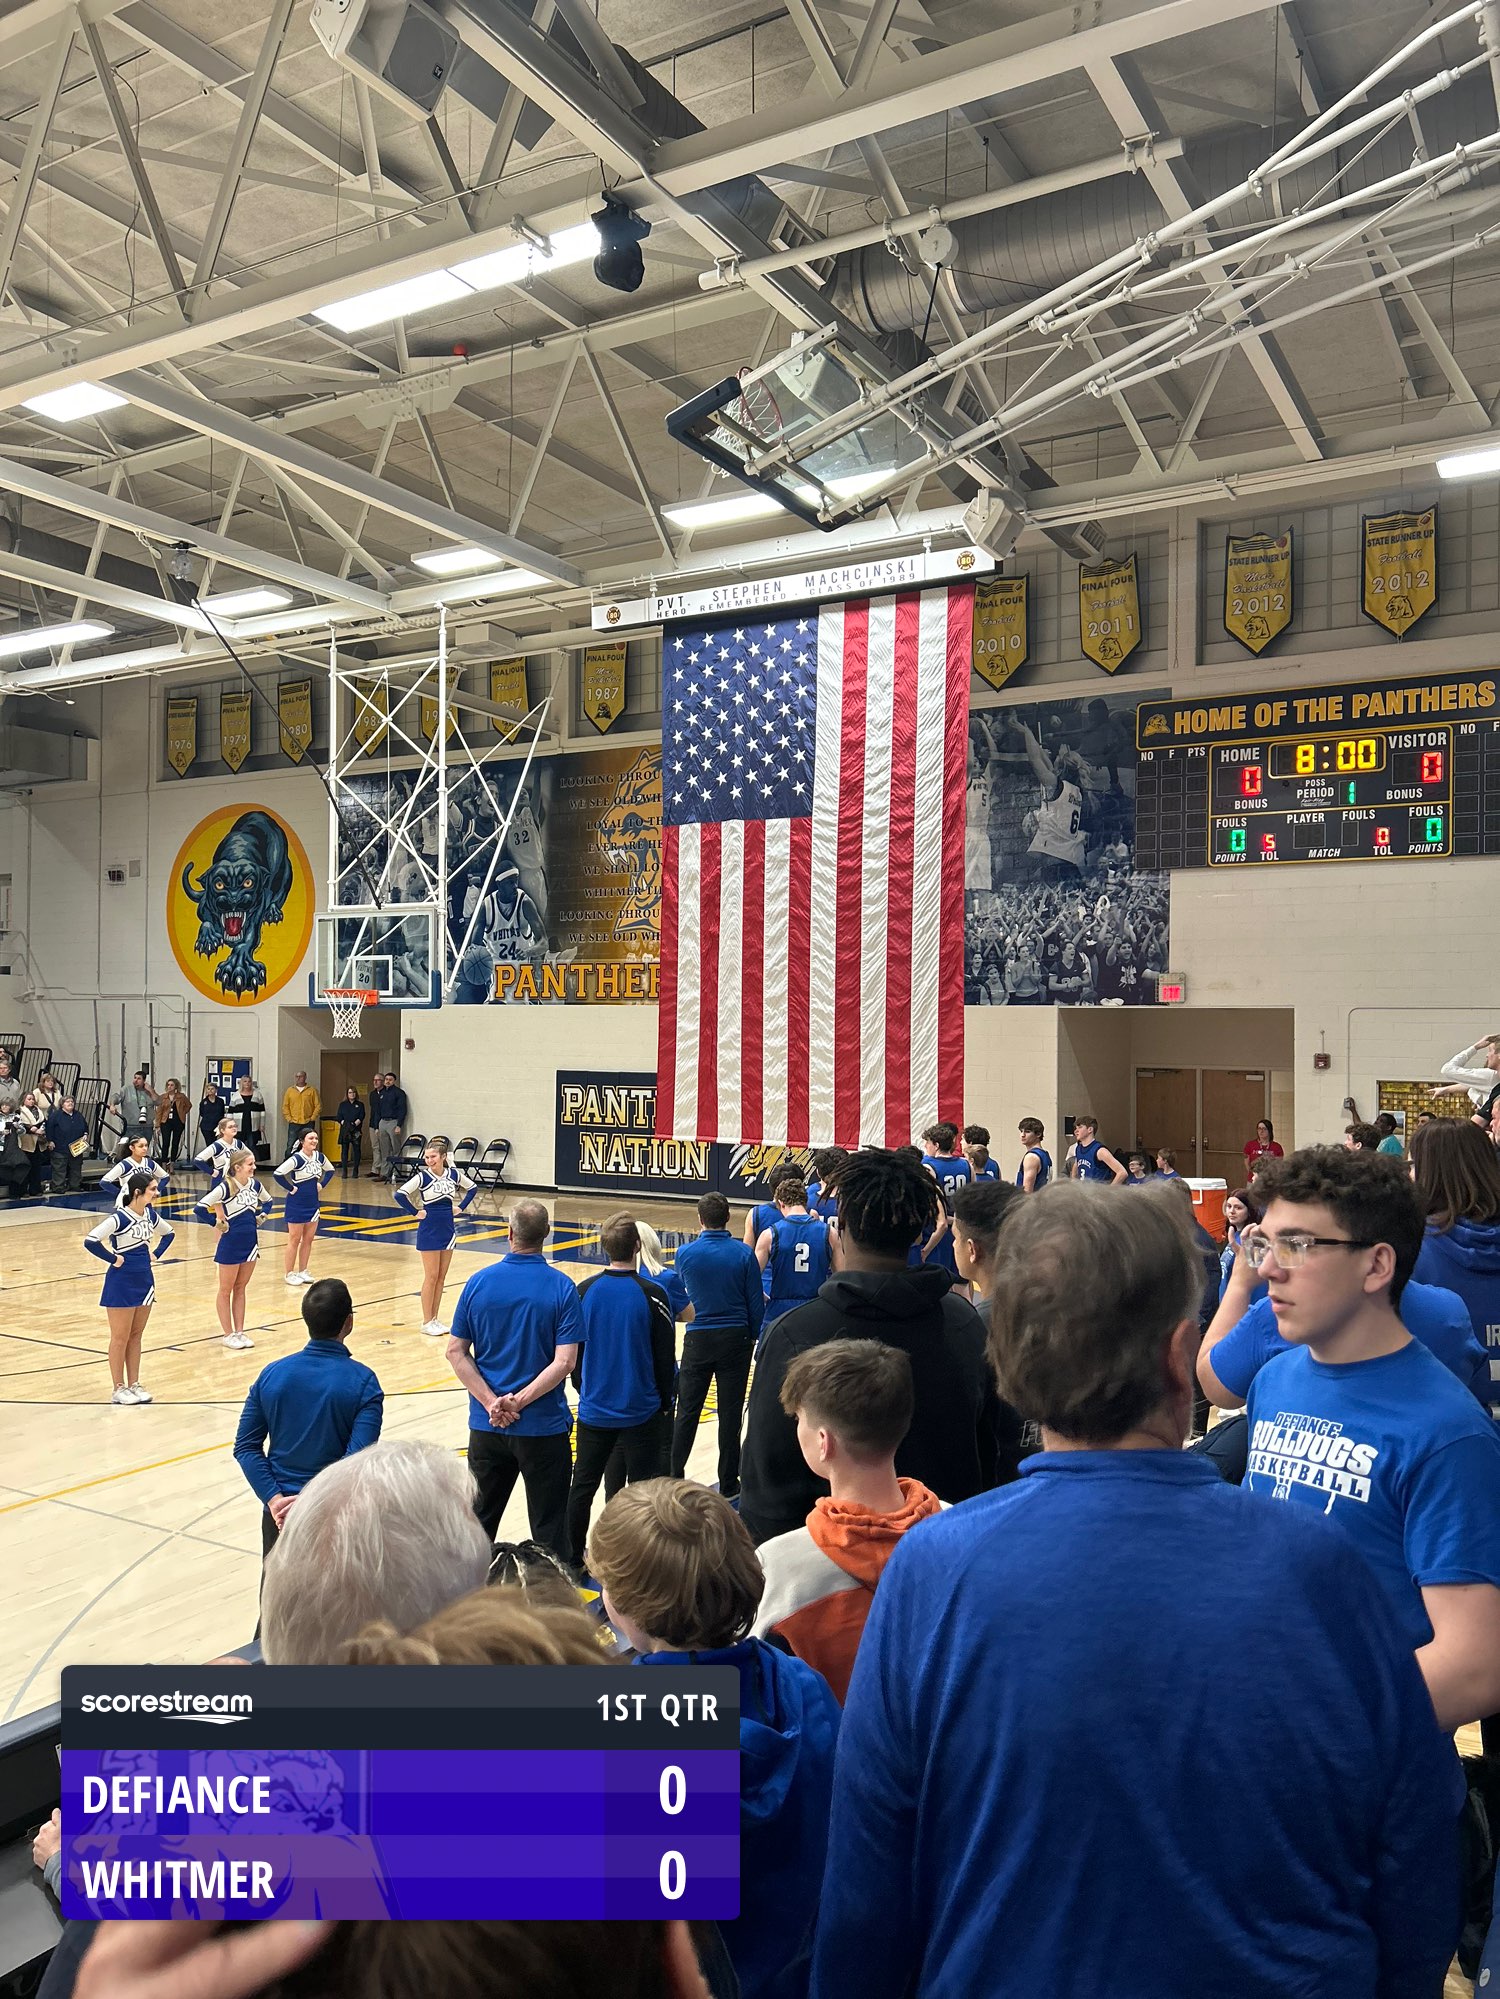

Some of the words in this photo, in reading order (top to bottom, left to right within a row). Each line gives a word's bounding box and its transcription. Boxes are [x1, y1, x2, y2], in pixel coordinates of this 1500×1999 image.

[1367, 536, 1390, 547] STATE
[1390, 531, 1423, 544] RUNNER
[1424, 529, 1434, 538] UP
[1230, 558, 1250, 566] STATE
[1250, 554, 1279, 564] RUNNER
[1281, 551, 1290, 560] UP
[658, 596, 690, 610] PVT.
[713, 581, 782, 601] STEPHEN
[805, 559, 914, 587] MACHCINSKI
[1081, 582, 1108, 592] FINAL
[1110, 574, 1134, 587] FOUR
[1372, 570, 1429, 594] 2012
[656, 608, 686, 618] HERO
[700, 593, 786, 612] REMEMBERED
[810, 583, 852, 595] CLASS
[860, 580, 874, 588] OF
[883, 573, 915, 584] 1989
[975, 601, 998, 609] FINAL
[1000, 596, 1024, 606] FOUR
[1232, 594, 1286, 616] 2012
[1088, 616, 1134, 638] 2011
[976, 635, 1021, 654] 2010
[587, 687, 619, 700] 1987
[1174, 706, 1246, 734] HOME
[1254, 702, 1287, 727] OF
[1293, 696, 1343, 724] THE
[1352, 681, 1496, 718] PANTHERS
[1461, 724, 1476, 734] NO
[1493, 721, 1500, 732] F
[170, 739, 192, 750] 1976
[224, 734, 248, 746] 1979
[1388, 732, 1446, 749] VISITOR
[1140, 751, 1154, 761] NO
[1169, 750, 1174, 758] F
[1188, 747, 1206, 757] PTS
[1221, 748, 1260, 762] HOME
[1296, 740, 1376, 774] 8:00
[1422, 752, 1442, 782] 0
[560, 775, 614, 788] LOOKING
[1243, 766, 1262, 796] 0
[1306, 778, 1326, 787] POSS
[1296, 787, 1334, 798] PERIOD
[1386, 788, 1423, 800] BONUS
[569, 800, 586, 810] WE
[590, 798, 610, 808] SEE
[614, 796, 638, 806] OLD
[1234, 799, 1268, 809] BONUS
[1342, 810, 1376, 821] FOULS
[1409, 806, 1444, 816] FOULS
[586, 819, 624, 830] LOYAL
[628, 818, 644, 828] TO
[1070, 810, 1080, 834] 6
[1216, 818, 1247, 828] FOULS
[1287, 813, 1325, 824] PLAYER
[514, 830, 530, 846] 32
[588, 842, 617, 853] EVER
[622, 840, 644, 851] ARE
[1308, 848, 1340, 858] MATCH
[1373, 846, 1393, 856] TOL
[1408, 843, 1444, 854] POINTS
[1215, 853, 1246, 863] POINTS
[1260, 852, 1279, 860] TOL
[584, 866, 600, 875] WE
[604, 864, 640, 874] SHALL
[584, 887, 641, 898] WHITMER
[560, 910, 613, 921] LOOKING
[568, 933, 585, 944] WE
[589, 932, 610, 943] SEE
[614, 932, 637, 942] OLD
[499, 942, 516, 960] 24
[359, 973, 370, 984] 20
[561, 1084, 657, 1128] PANT
[579, 1132, 710, 1181] NATION
[795, 1242, 810, 1272] 2
[1274, 1412, 1343, 1438] DEFIANCE
[1251, 1420, 1379, 1476] BULLDOGS
